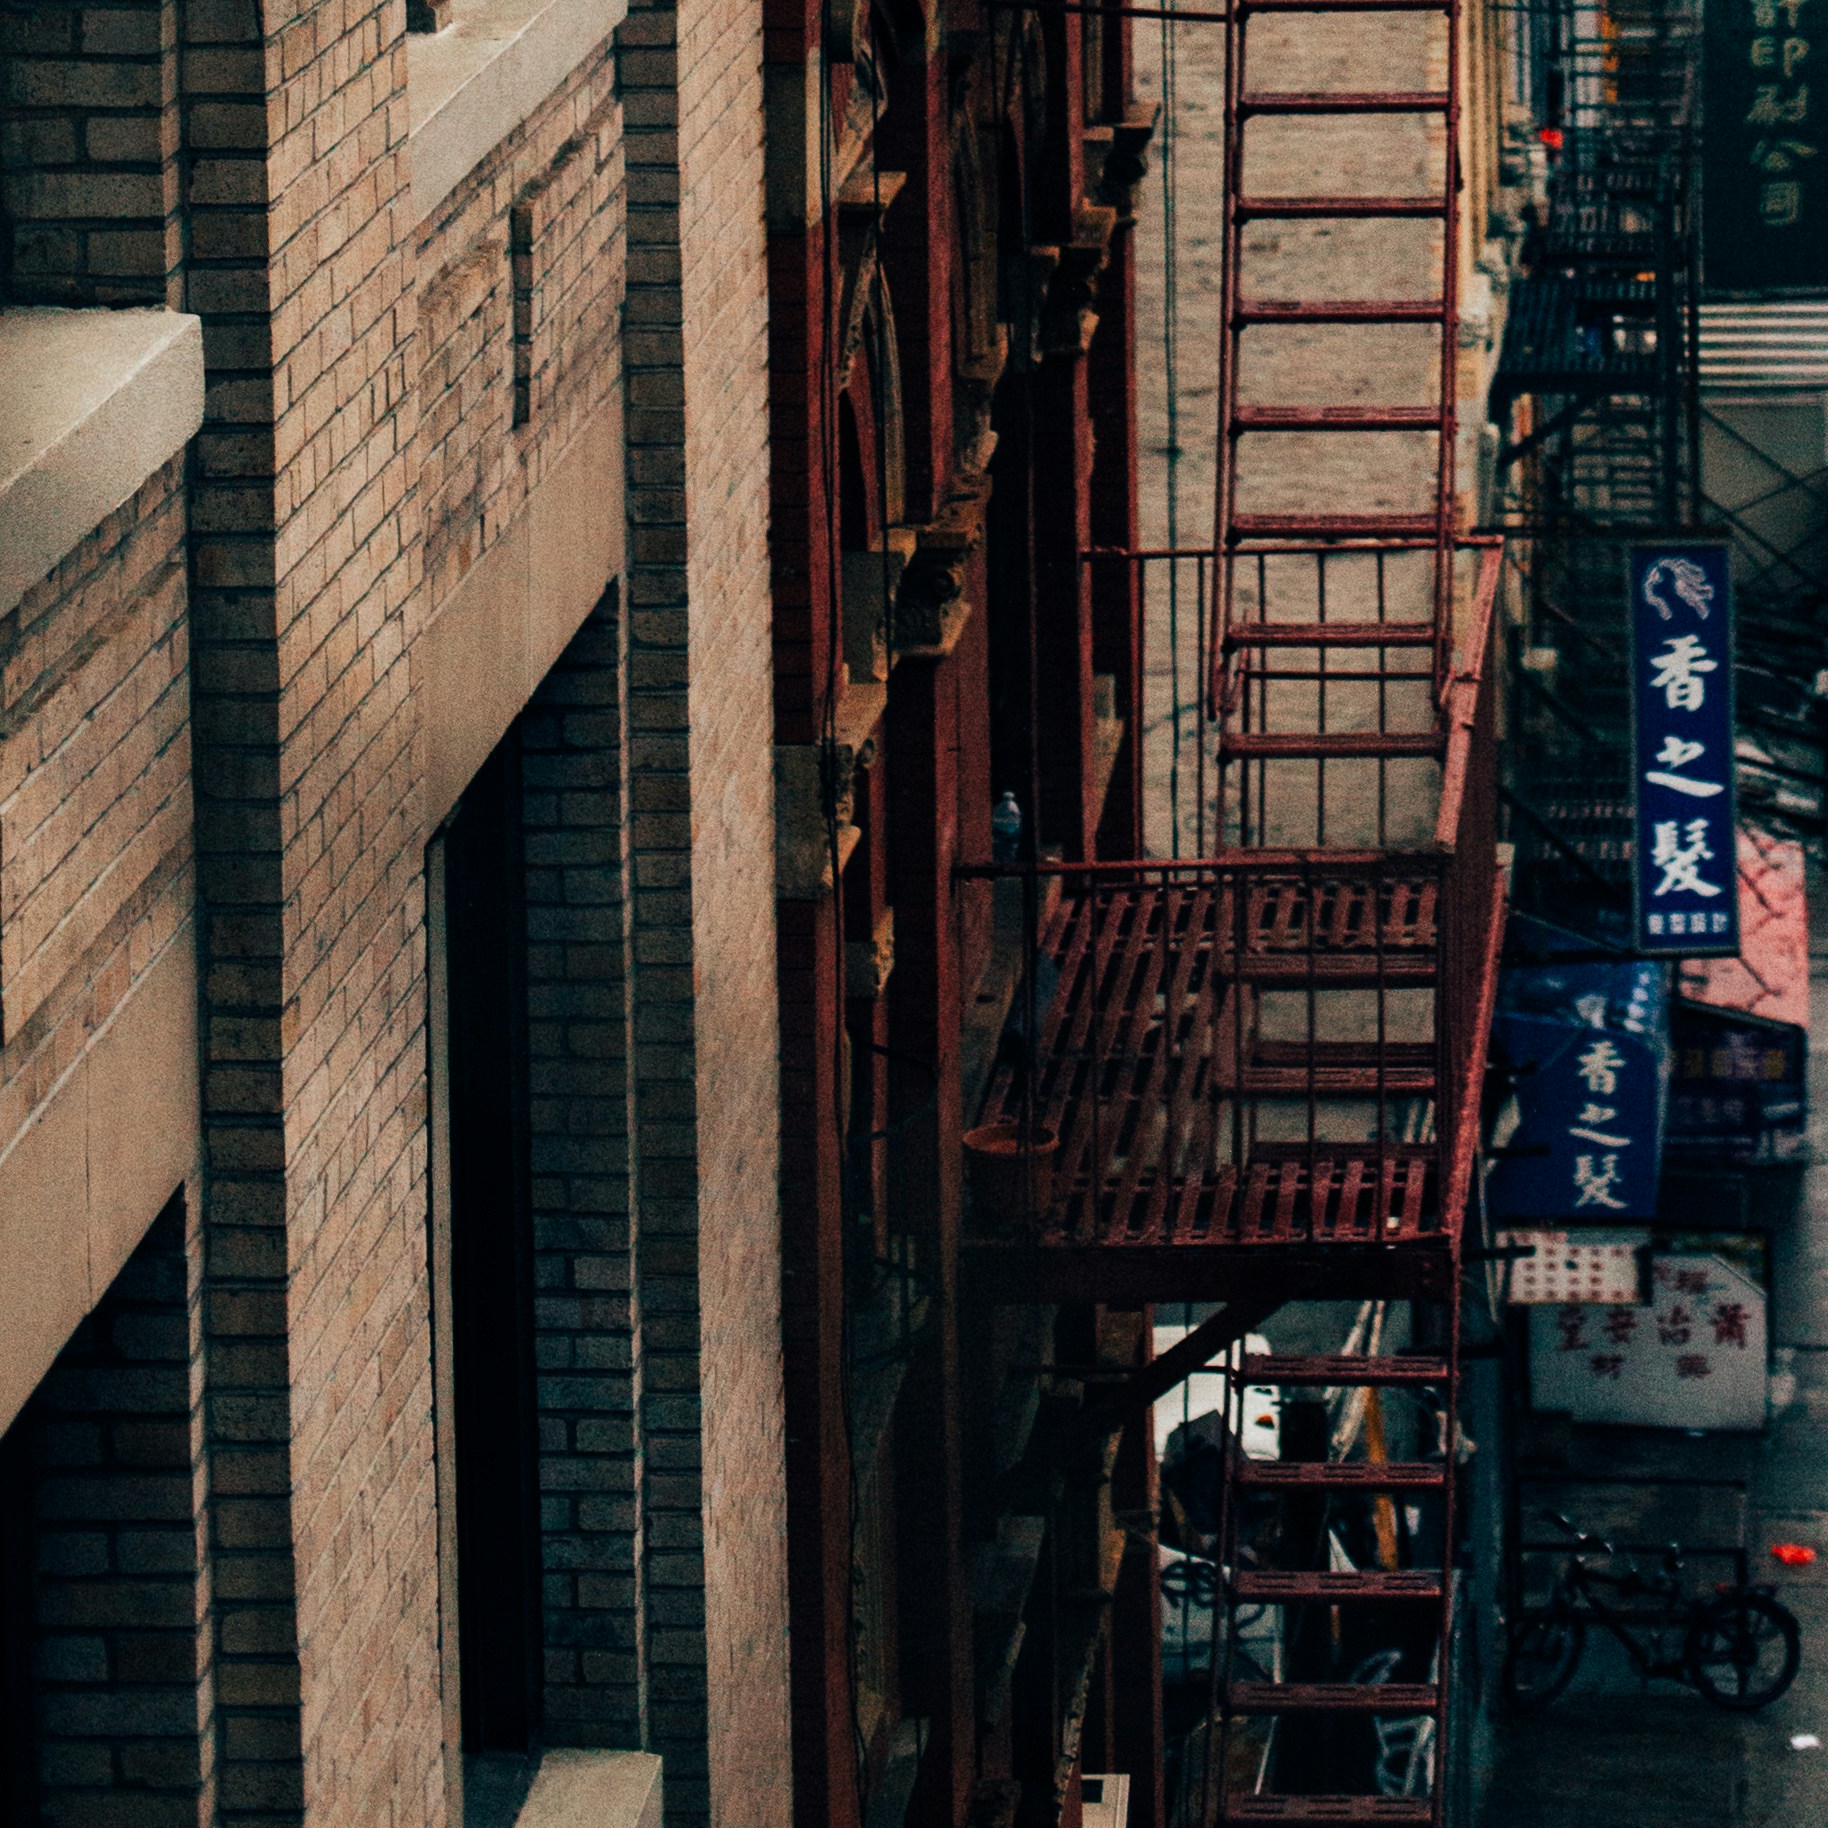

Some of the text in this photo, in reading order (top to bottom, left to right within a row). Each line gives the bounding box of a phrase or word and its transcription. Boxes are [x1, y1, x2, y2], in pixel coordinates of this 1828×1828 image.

[1645, 635, 1724, 897] 香之髮
[1570, 1040, 1631, 1210] 香之髮
